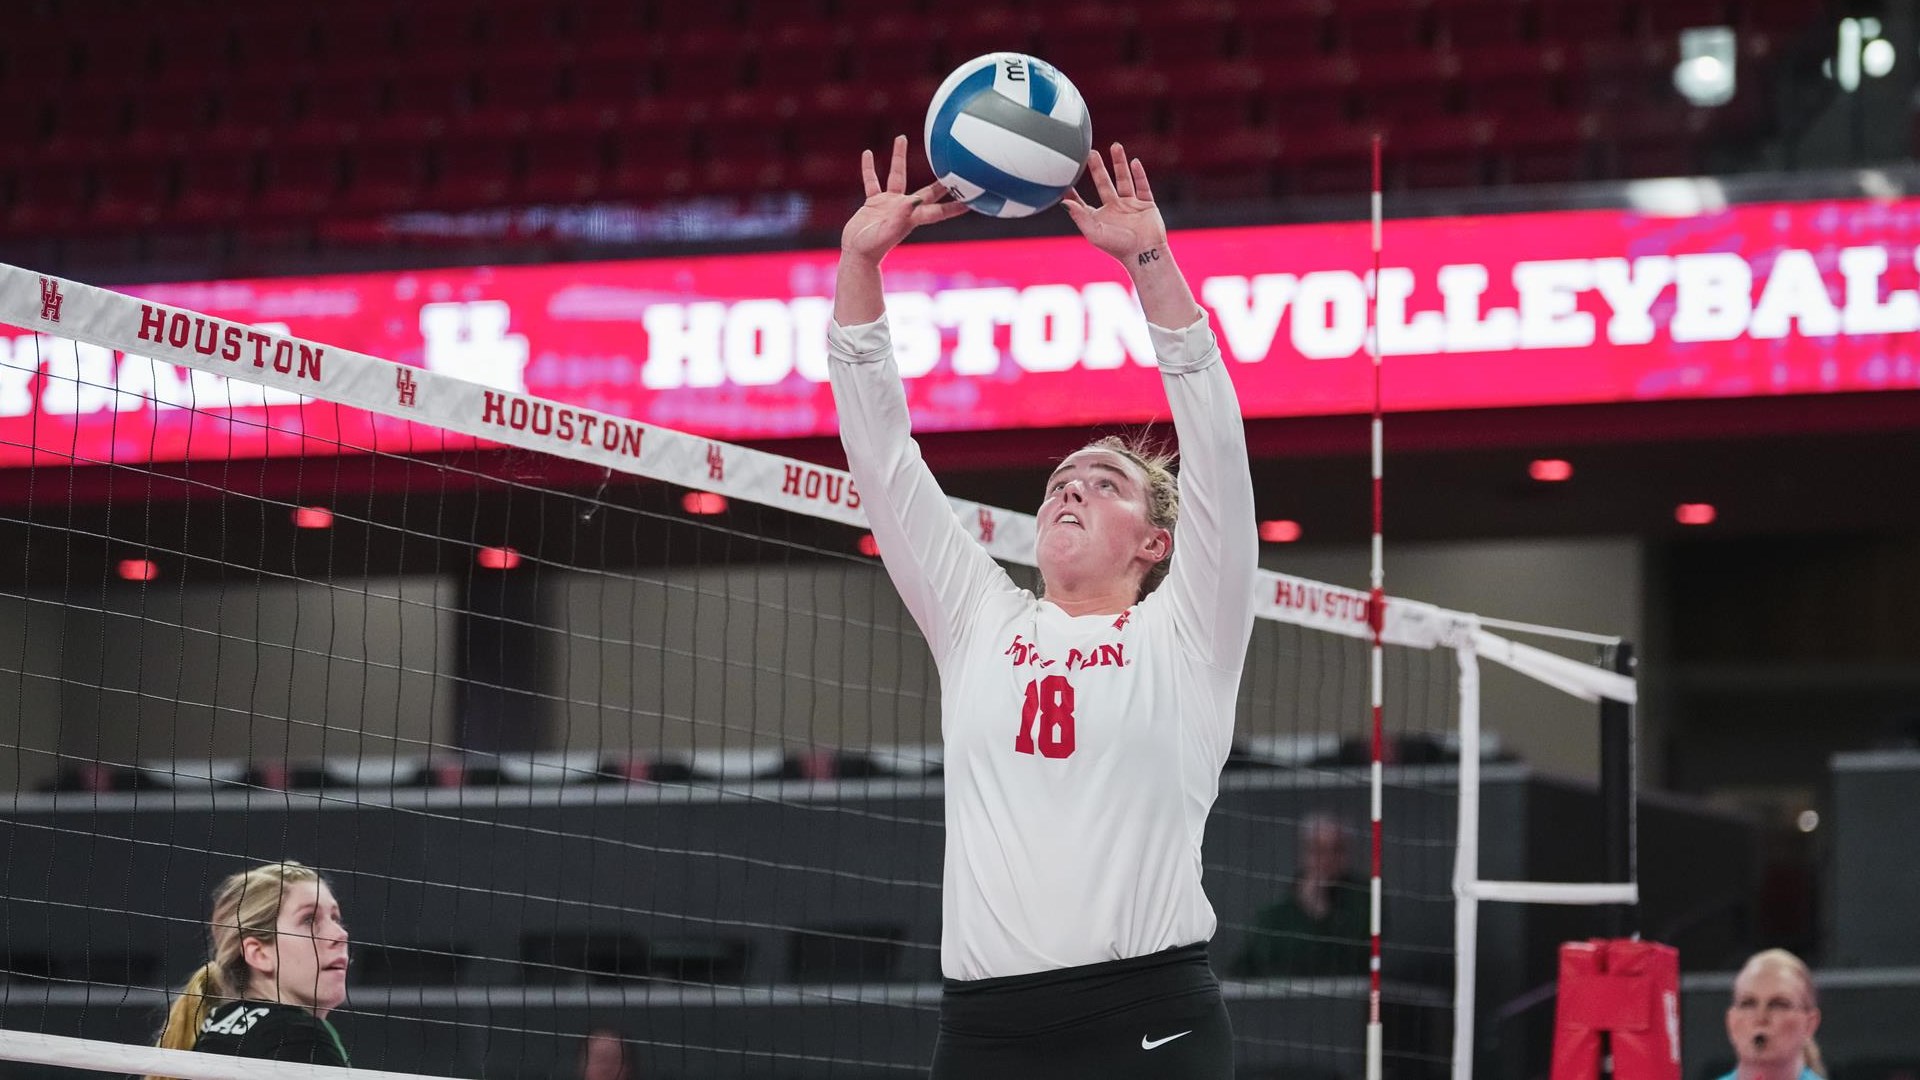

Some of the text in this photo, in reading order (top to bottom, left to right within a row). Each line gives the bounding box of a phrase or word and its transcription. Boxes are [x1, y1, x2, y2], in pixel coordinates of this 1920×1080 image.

[1138, 248, 1160, 266] AFC
[1202, 244, 1920, 363] VOLLEYBAL
[137, 304, 325, 382] HOUSTON
[482, 390, 645, 458] HOUSTON
[1275, 580, 1386, 627] HOUSTO
[1015, 674, 1076, 759] 18
